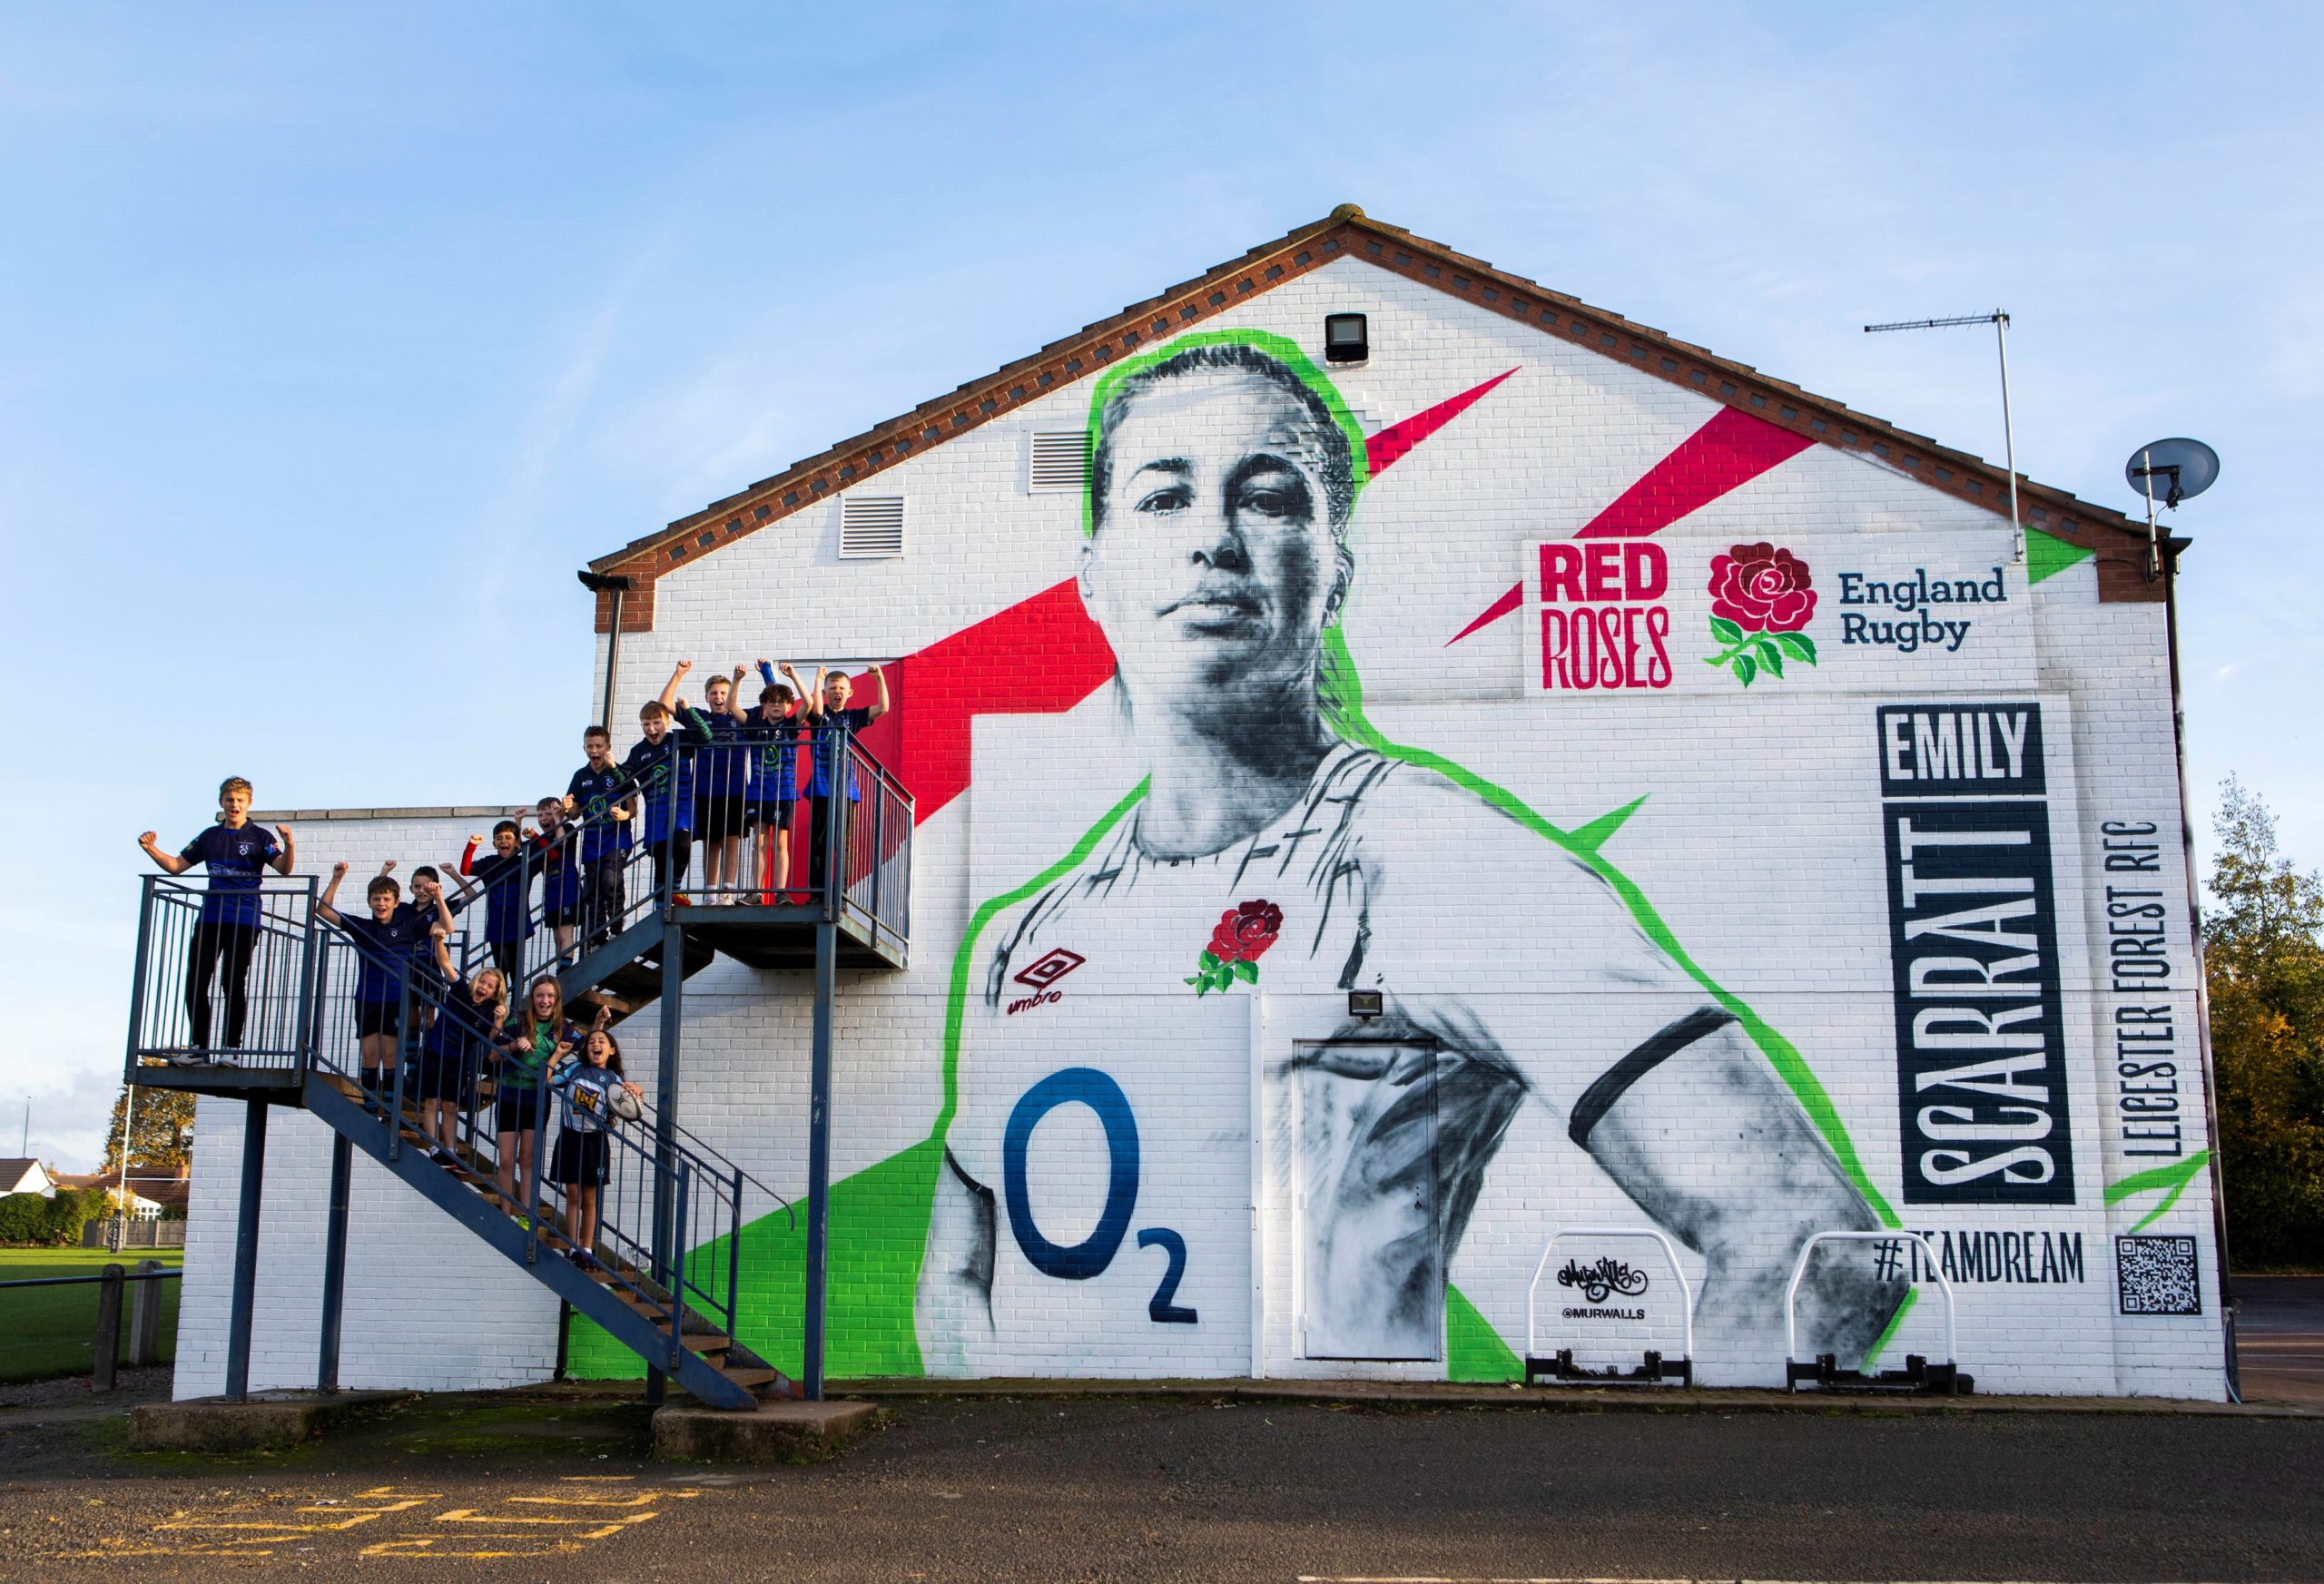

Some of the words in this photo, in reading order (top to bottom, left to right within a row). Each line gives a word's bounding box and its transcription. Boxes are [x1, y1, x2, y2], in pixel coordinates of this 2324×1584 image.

[1540, 543, 1669, 602] RED
[1838, 566, 2007, 612] England
[1541, 605, 1672, 690] ROSES
[1840, 608, 1971, 653] Rugby
[1885, 712, 2028, 780] EMILY
[2100, 822, 2160, 871] RFC
[2106, 885, 2171, 992] FOREST
[1008, 989, 1062, 1015] umbro
[1899, 818, 2055, 1185] SCARRATT
[2115, 1005, 2181, 1156] LEICESTER
[1873, 1230, 2084, 1284] #TEAMDREAM
[1562, 1307, 1645, 1320] @MURWALLS
